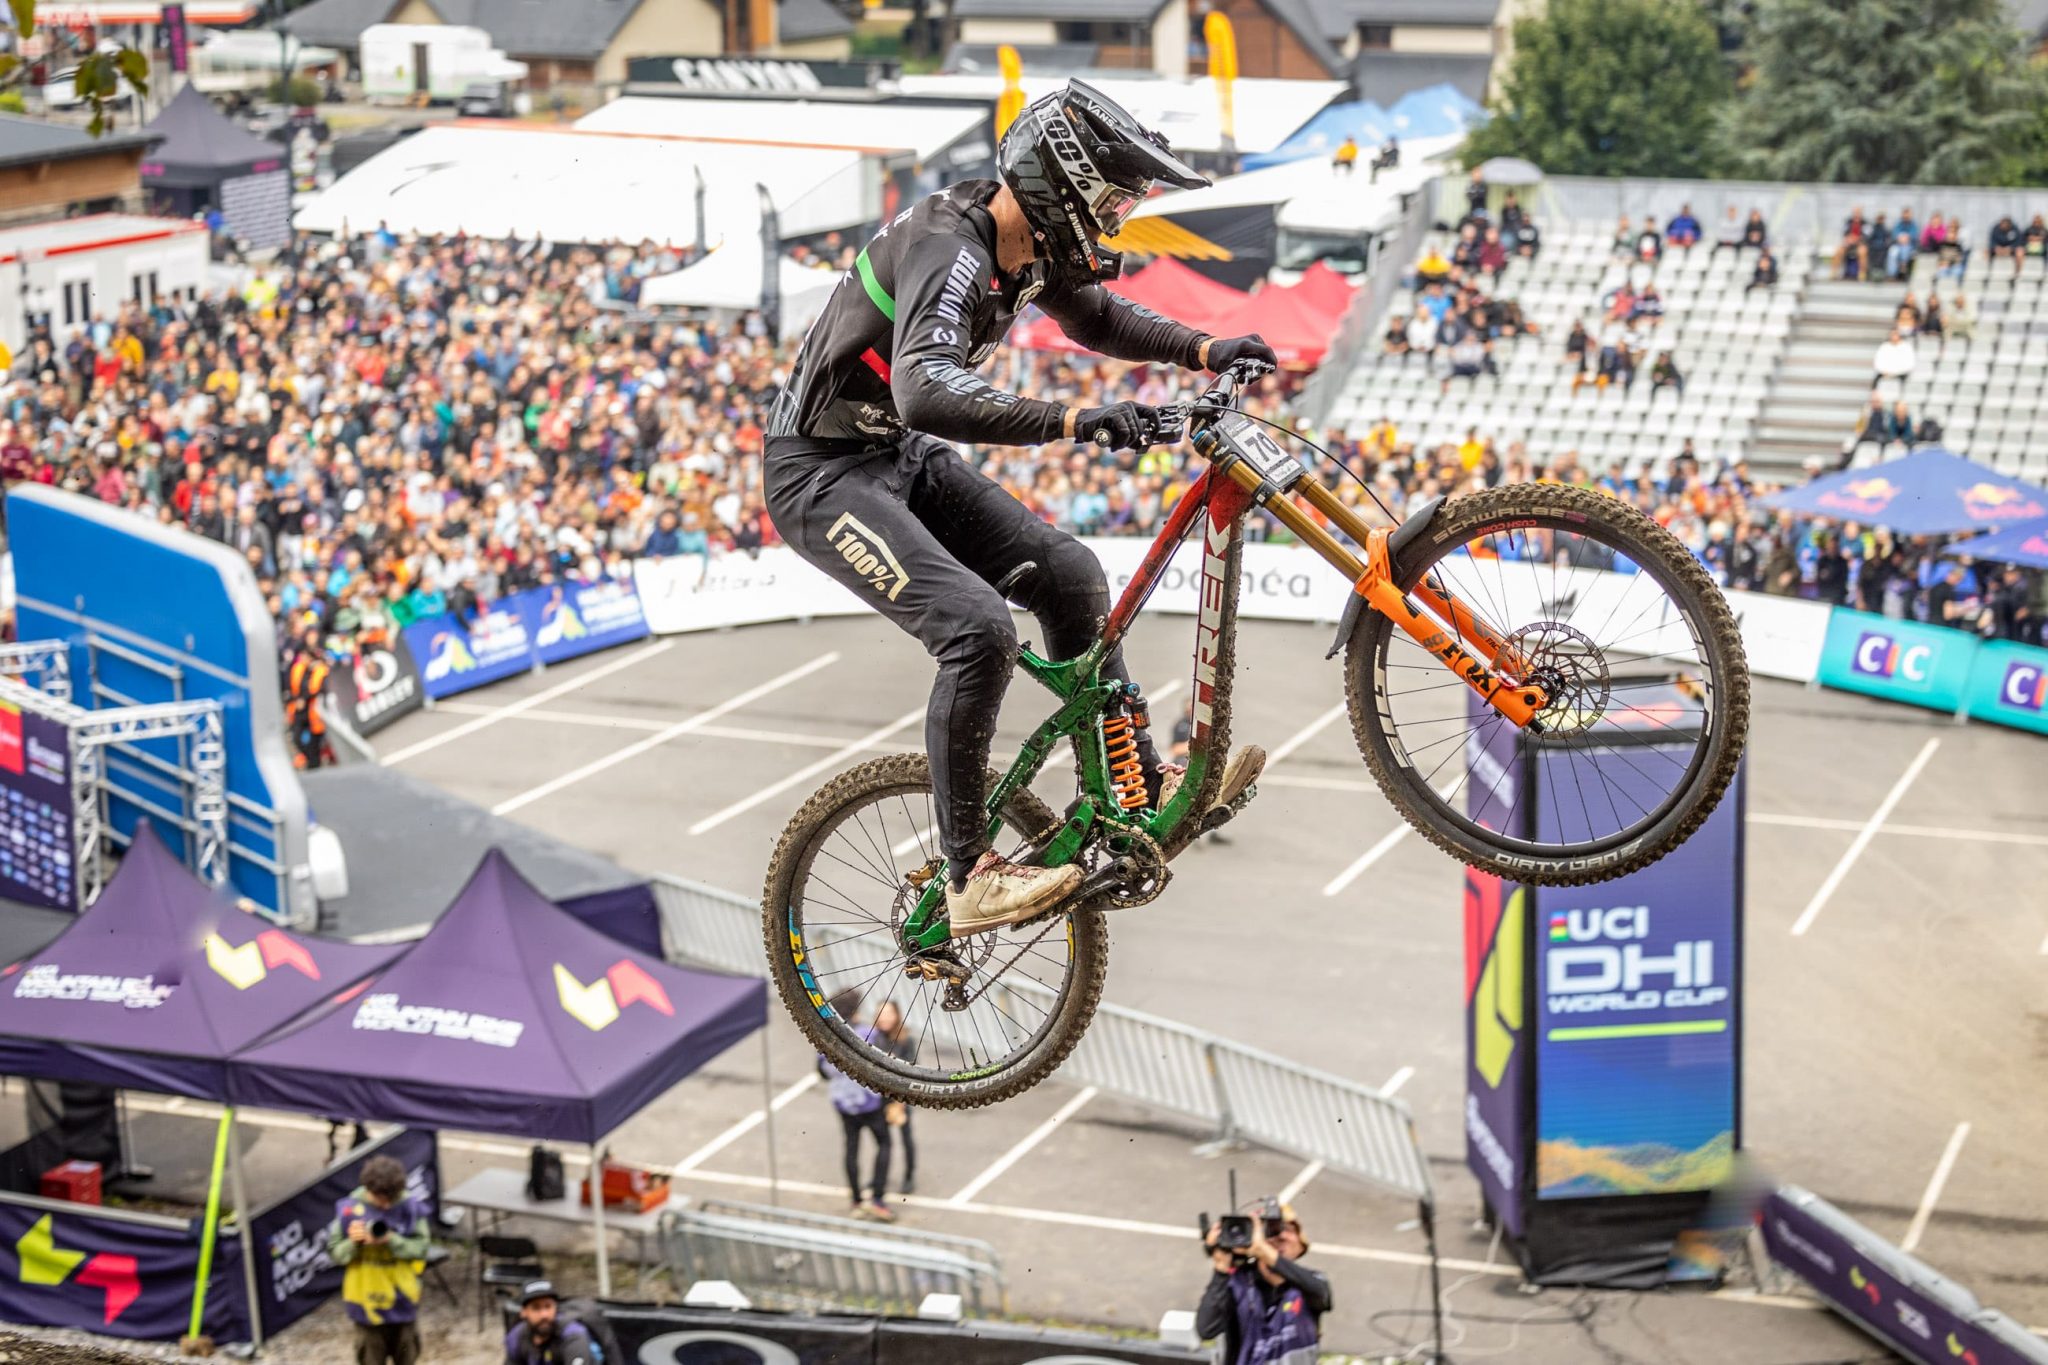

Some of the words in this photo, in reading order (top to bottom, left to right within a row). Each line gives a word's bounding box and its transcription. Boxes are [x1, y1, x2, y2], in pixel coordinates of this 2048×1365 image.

[1087, 100, 1119, 128] VANS
[1068, 212, 1087, 244] UNIOR
[937, 249, 981, 326] UNIOR
[1244, 431, 1281, 464] 70
[1432, 507, 1566, 545] SCHWALBE
[835, 531, 895, 592] 100%
[1192, 513, 1232, 740] TREK
[1443, 642, 1491, 693] FOX
[1857, 636, 1931, 682] CIC
[1493, 852, 1566, 872] DIRTY
[1567, 906, 1649, 941] UCI
[1547, 940, 1714, 995] DHI
[1547, 992, 1662, 1014] WORLD
[1664, 987, 1728, 1008] CUP
[908, 1082, 973, 1096] DIRTY
